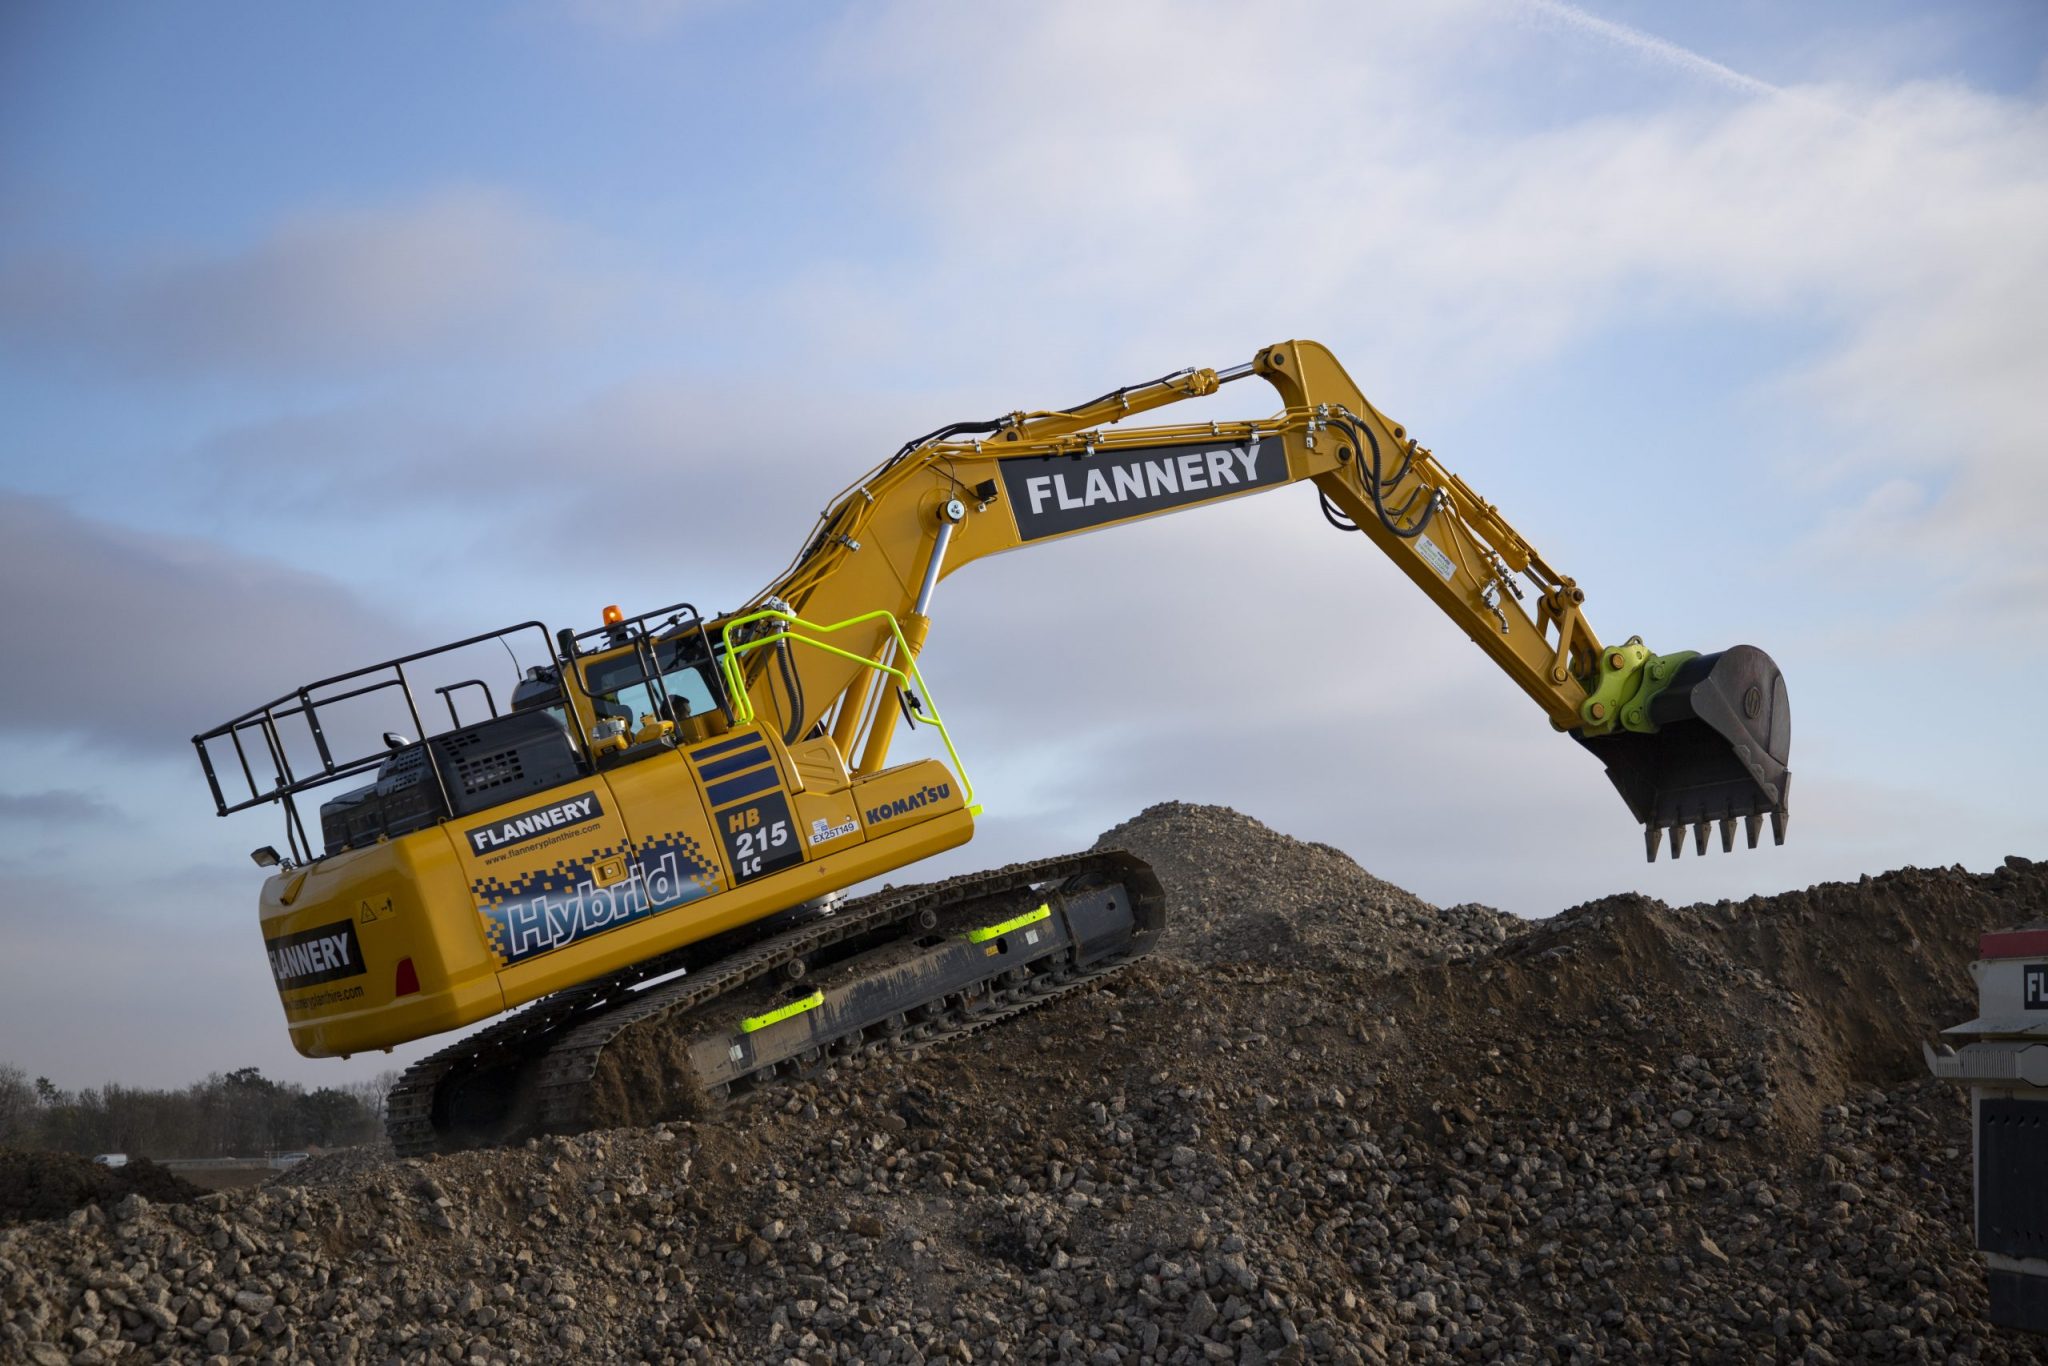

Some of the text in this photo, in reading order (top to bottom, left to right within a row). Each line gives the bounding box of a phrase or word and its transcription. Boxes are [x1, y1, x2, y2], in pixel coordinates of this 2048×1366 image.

[1026, 445, 1261, 514] FLANNERY
[473, 797, 591, 850] FLANNERY
[728, 807, 761, 834] HB
[866, 783, 950, 825] KOMATSU
[485, 822, 601, 866] www.flanneryplanthire.com
[736, 820, 789, 859] 215
[813, 822, 855, 844] EX25T149
[742, 856, 762, 877] LC
[507, 852, 681, 956] Hybrid
[268, 932, 350, 980] FLANNERY
